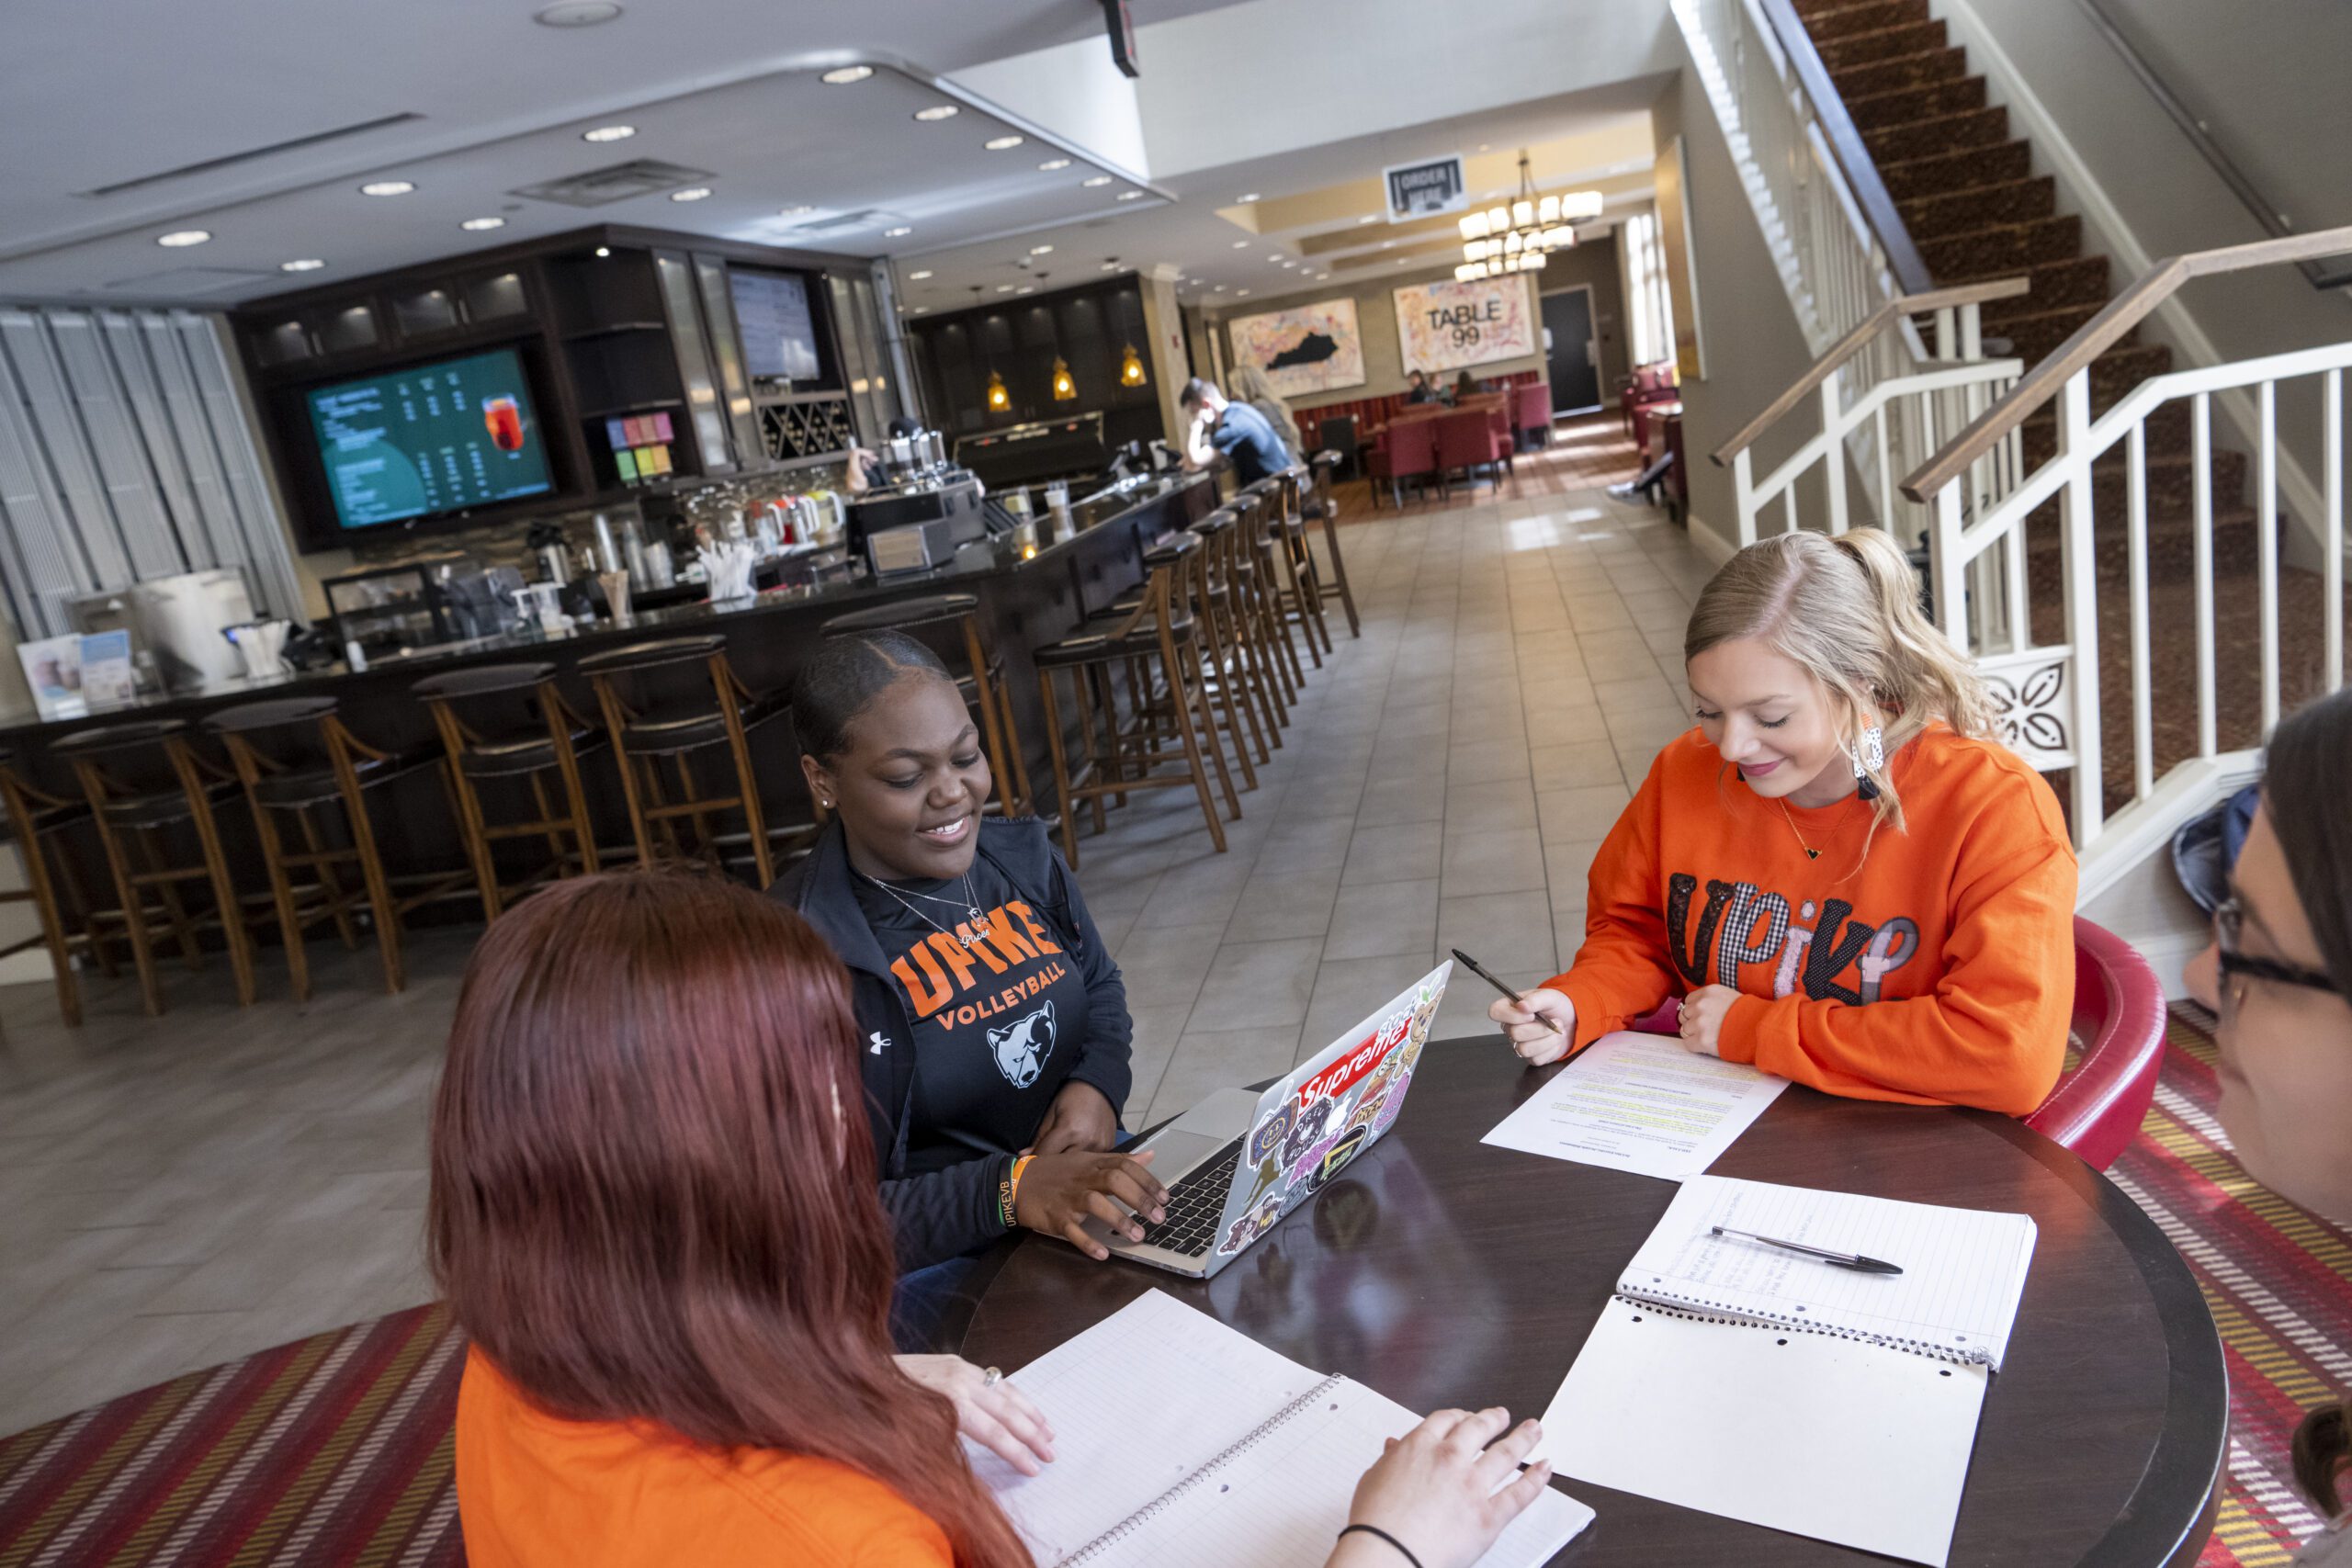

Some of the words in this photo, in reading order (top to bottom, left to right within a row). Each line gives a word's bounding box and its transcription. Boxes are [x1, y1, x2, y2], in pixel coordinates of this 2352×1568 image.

[1426, 299, 1502, 330] TABLE
[1453, 326, 1480, 348] 99
[890, 900, 1063, 1017] UPIKE
[935, 962, 1066, 1031] VOLLEYBALL
[1300, 1023, 1403, 1111] Supreme
[1000, 1180, 1017, 1227] UPIKEVB
